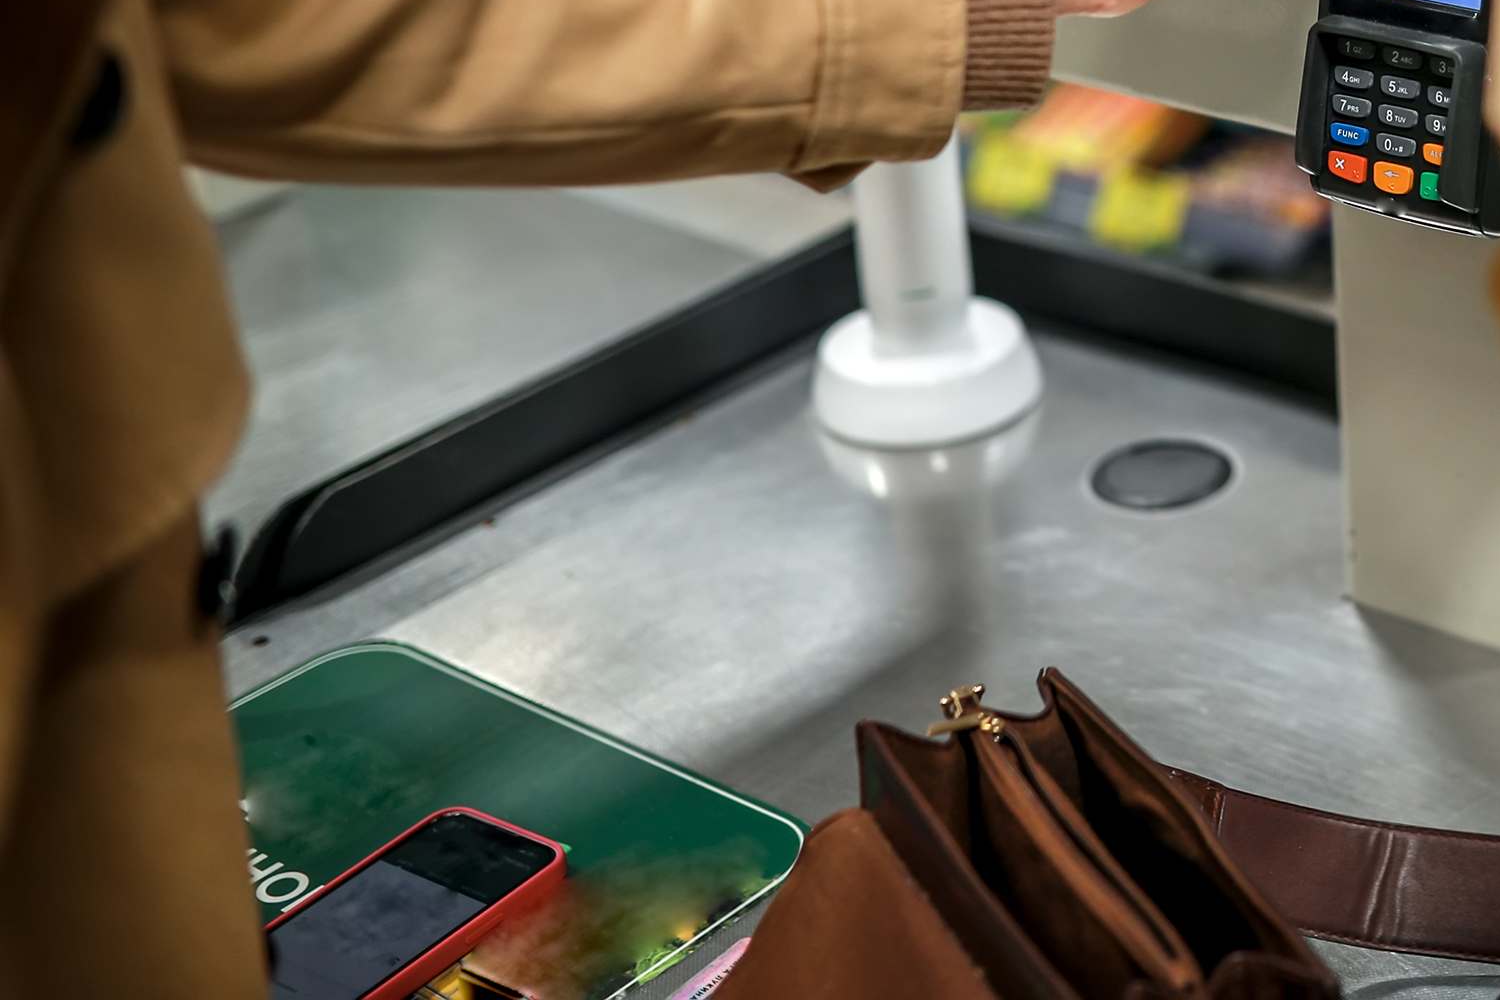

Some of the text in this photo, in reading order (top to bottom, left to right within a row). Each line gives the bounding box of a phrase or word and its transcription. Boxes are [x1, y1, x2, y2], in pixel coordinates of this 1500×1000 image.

[1345, 41, 1350, 53] 1
[1391, 51, 1399, 63] 2
[1439, 61, 1446, 73] 3
[1341, 71, 1361, 84] 4 GHI
[1388, 81, 1409, 95] 5 JKL
[1435, 91, 1443, 103] 6
[1340, 99, 1360, 113] 7 PRS
[1386, 109, 1406, 123] 8 TUV
[1433, 120, 1440, 131] 9
[1337, 128, 1360, 140] FUNC
[1384, 138, 1392, 151] 0
